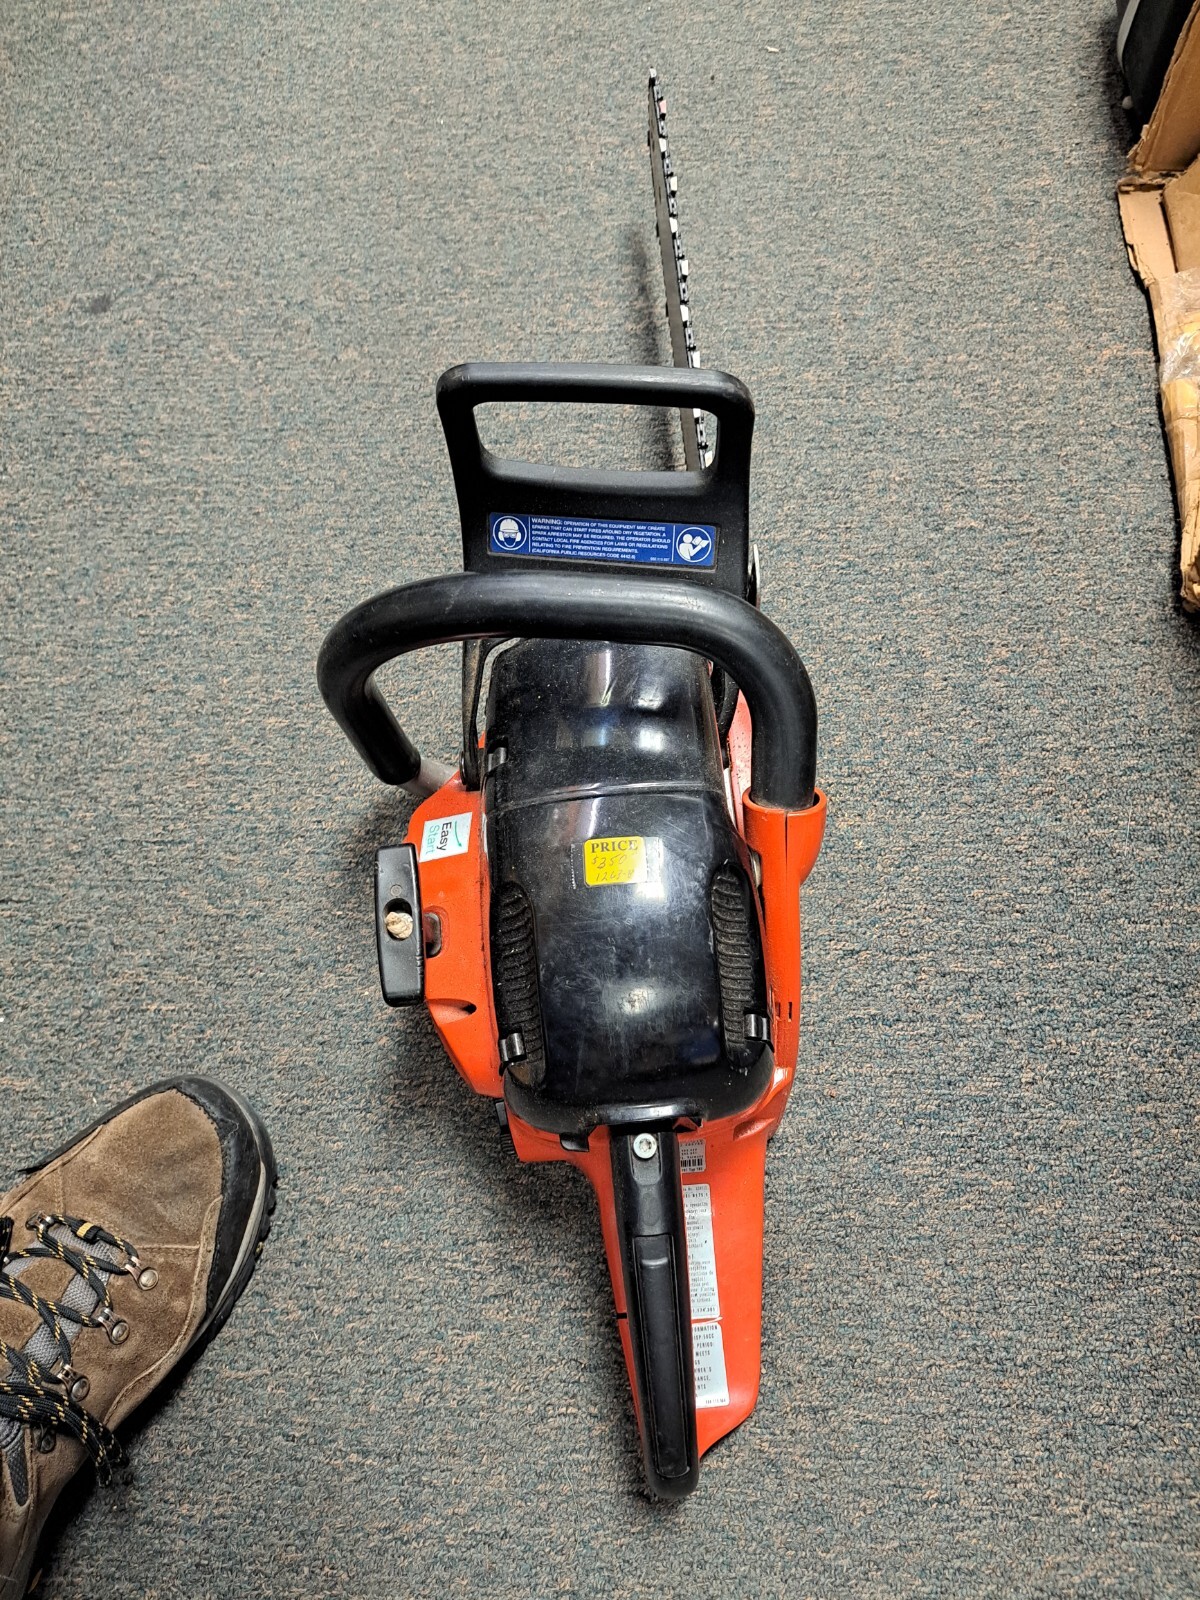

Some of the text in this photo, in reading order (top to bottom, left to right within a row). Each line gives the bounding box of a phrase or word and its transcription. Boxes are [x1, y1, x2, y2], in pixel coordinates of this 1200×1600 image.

[426, 824, 440, 855] Start
[436, 822, 452, 850] Easy
[591, 839, 638, 853] PRICE
